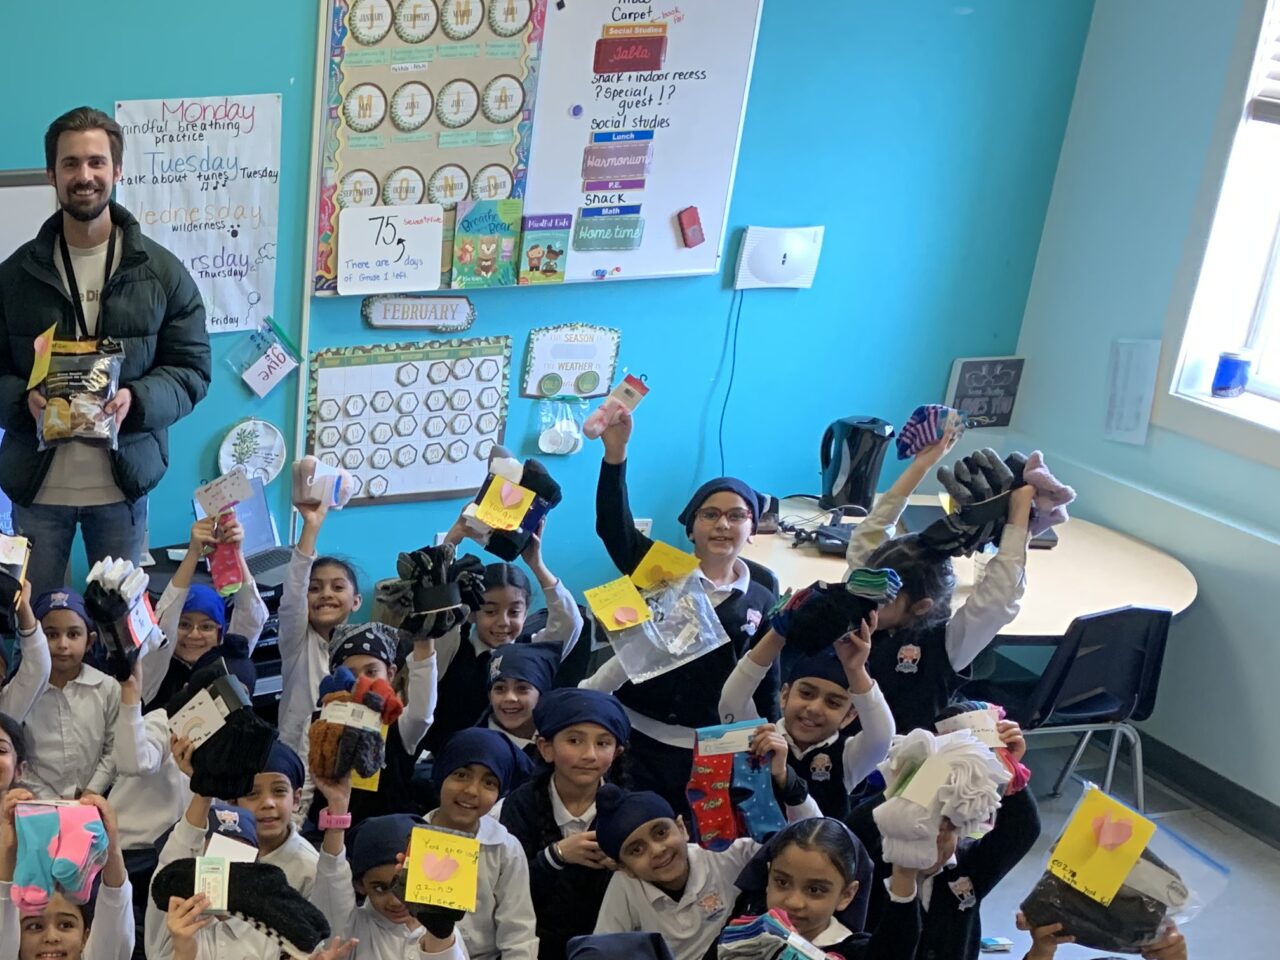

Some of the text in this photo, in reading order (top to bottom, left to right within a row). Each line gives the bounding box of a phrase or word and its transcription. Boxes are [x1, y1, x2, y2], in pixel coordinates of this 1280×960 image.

[612, 5, 653, 22] Carpet
[609, 26, 663, 35] Social Studies
[635, 70, 670, 83] indoor
[673, 70, 707, 80] recess
[617, 94, 653, 116] guest
[162, 98, 255, 134] Monday
[632, 114, 670, 128] studies
[178, 120, 240, 137] breathing
[155, 132, 204, 146] practice
[612, 133, 634, 141] Lunch
[144, 145, 239, 181] Tuesday
[587, 155, 649, 168] Harmonium
[120, 167, 279, 186] talk about tunes Tuesday
[601, 207, 620, 215] Math
[172, 221, 226, 232] wilderness
[368, 215, 398, 245] 75
[579, 226, 640, 239] Home time
[345, 256, 423, 270] There are days
[198, 268, 243, 281] Thursday
[344, 274, 353, 283] of
[383, 303, 460, 320] FEBRUARY
[211, 316, 239, 327] Friday
[564, 334, 594, 343] SEASON
[558, 362, 593, 371] WEATHER
